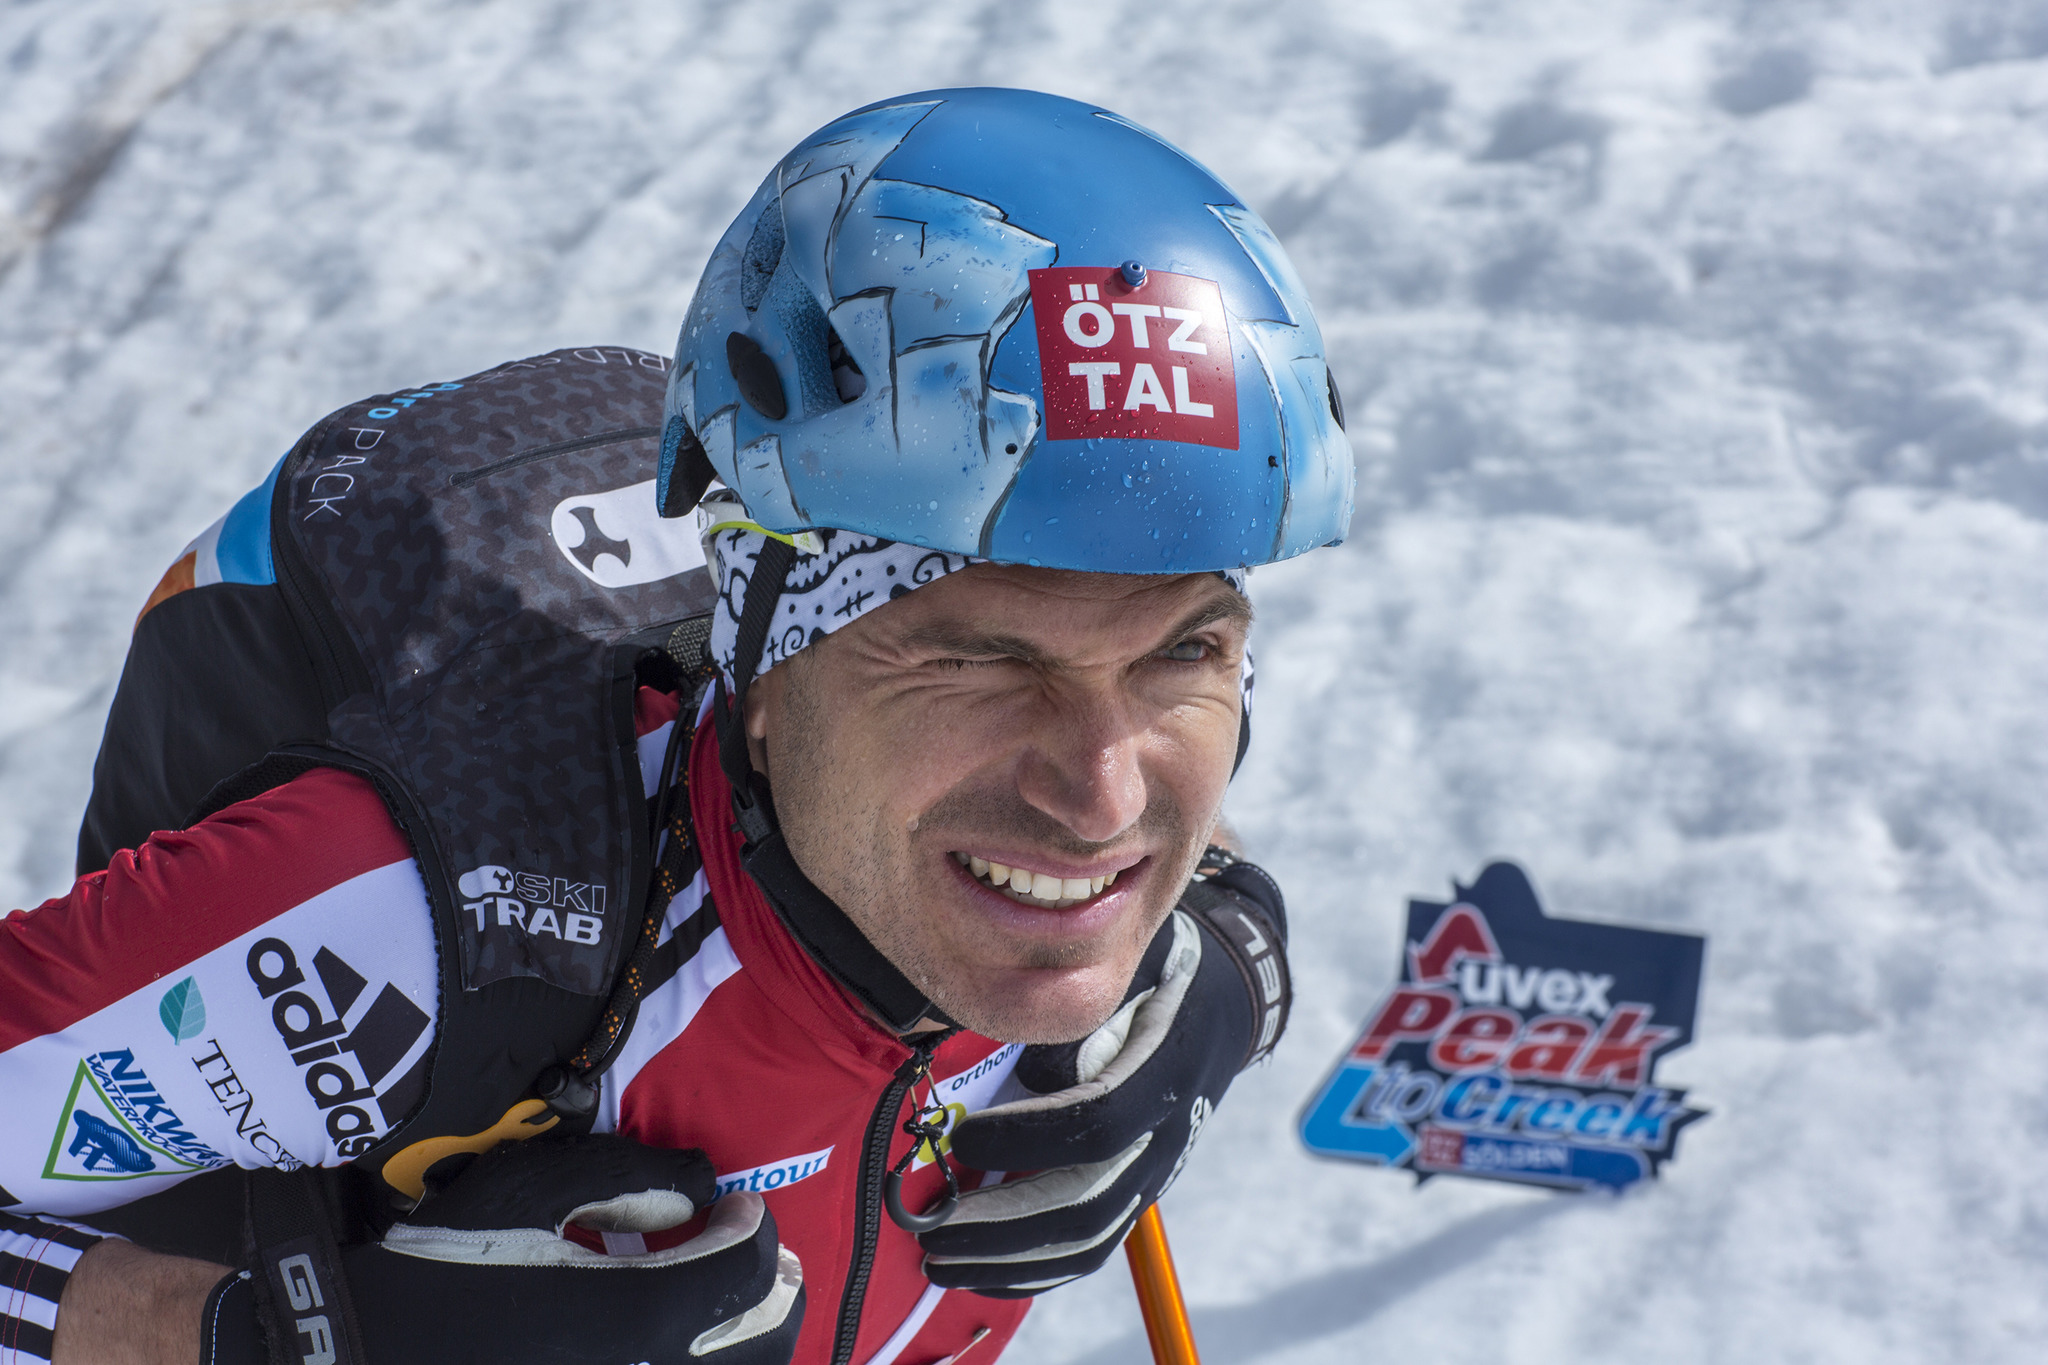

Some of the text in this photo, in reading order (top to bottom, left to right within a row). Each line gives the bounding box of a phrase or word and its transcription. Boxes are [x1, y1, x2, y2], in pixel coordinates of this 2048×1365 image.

[1063, 284, 1208, 355] ÖTZ
[574, 349, 666, 372] RLD
[1069, 362, 1214, 418] TAL
[303, 427, 385, 522] PACK
[463, 896, 604, 946] TRAB
[515, 871, 606, 914] SKI
[1459, 961, 1615, 1014] uvex
[246, 937, 379, 1158] adidas
[1349, 982, 1681, 1088] Peak
[1362, 1061, 1441, 1122] to
[1433, 1068, 1688, 1150] Creek
[279, 1253, 336, 1365] GA
